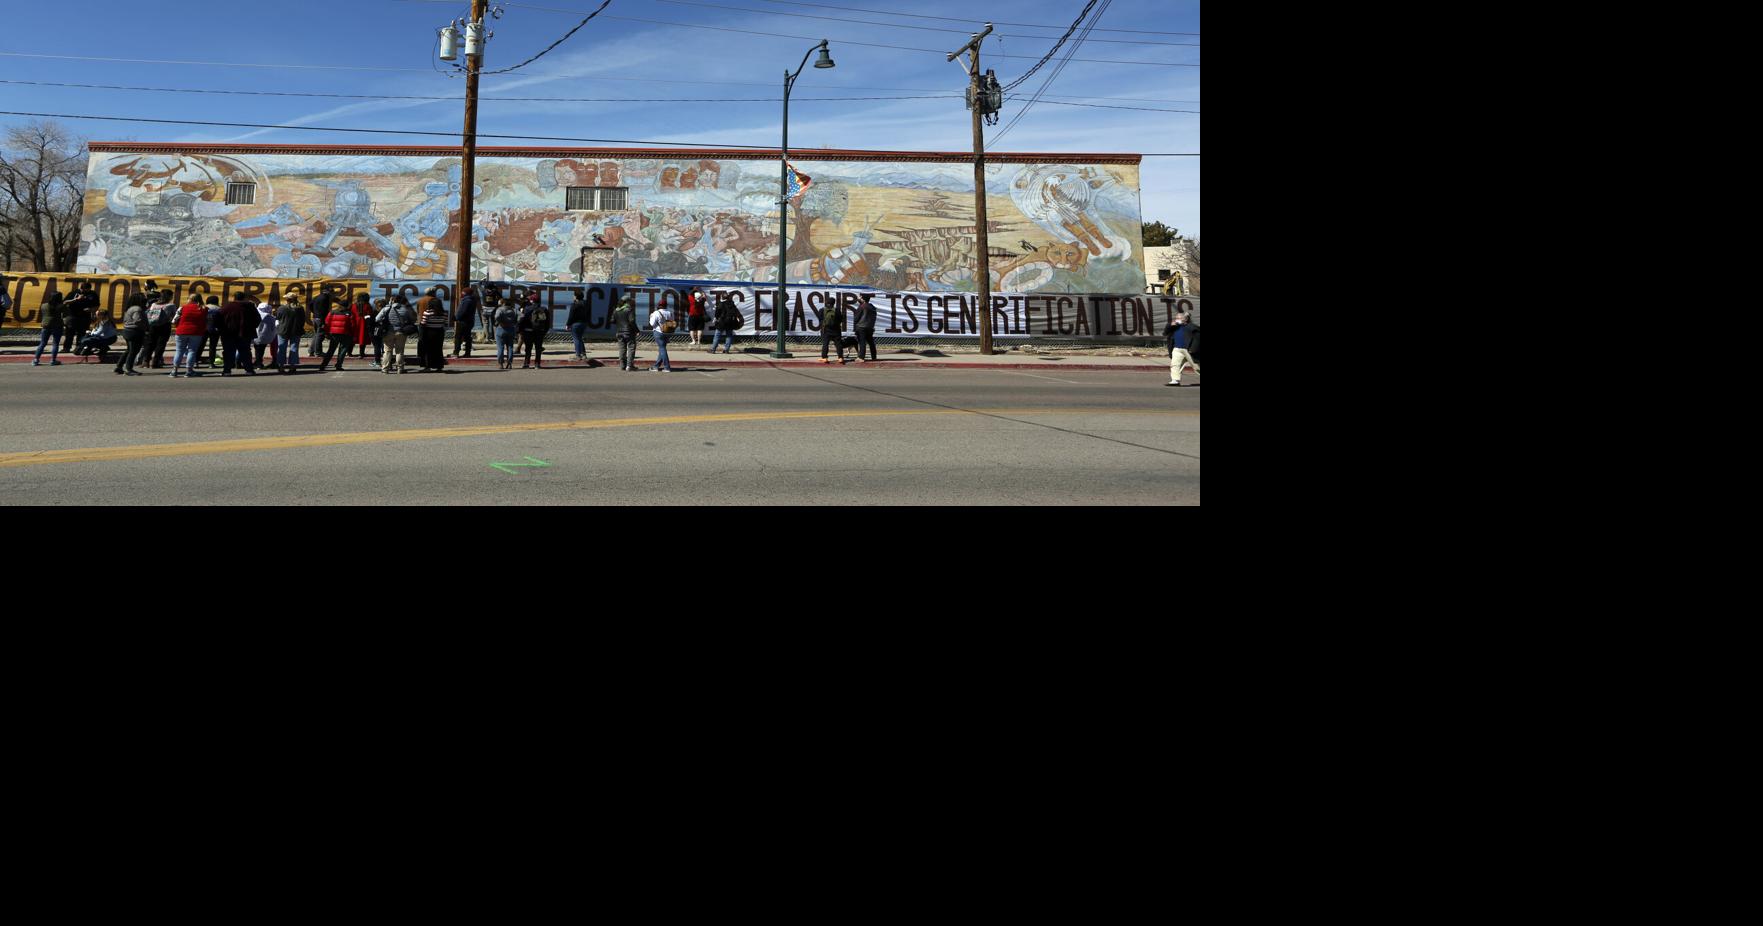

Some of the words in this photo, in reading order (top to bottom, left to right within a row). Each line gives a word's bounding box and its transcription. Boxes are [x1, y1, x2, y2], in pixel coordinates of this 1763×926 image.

[755, 290, 876, 332] ERASR
[885, 293, 918, 333] IS
[927, 295, 1154, 336] GENRIFICATION
